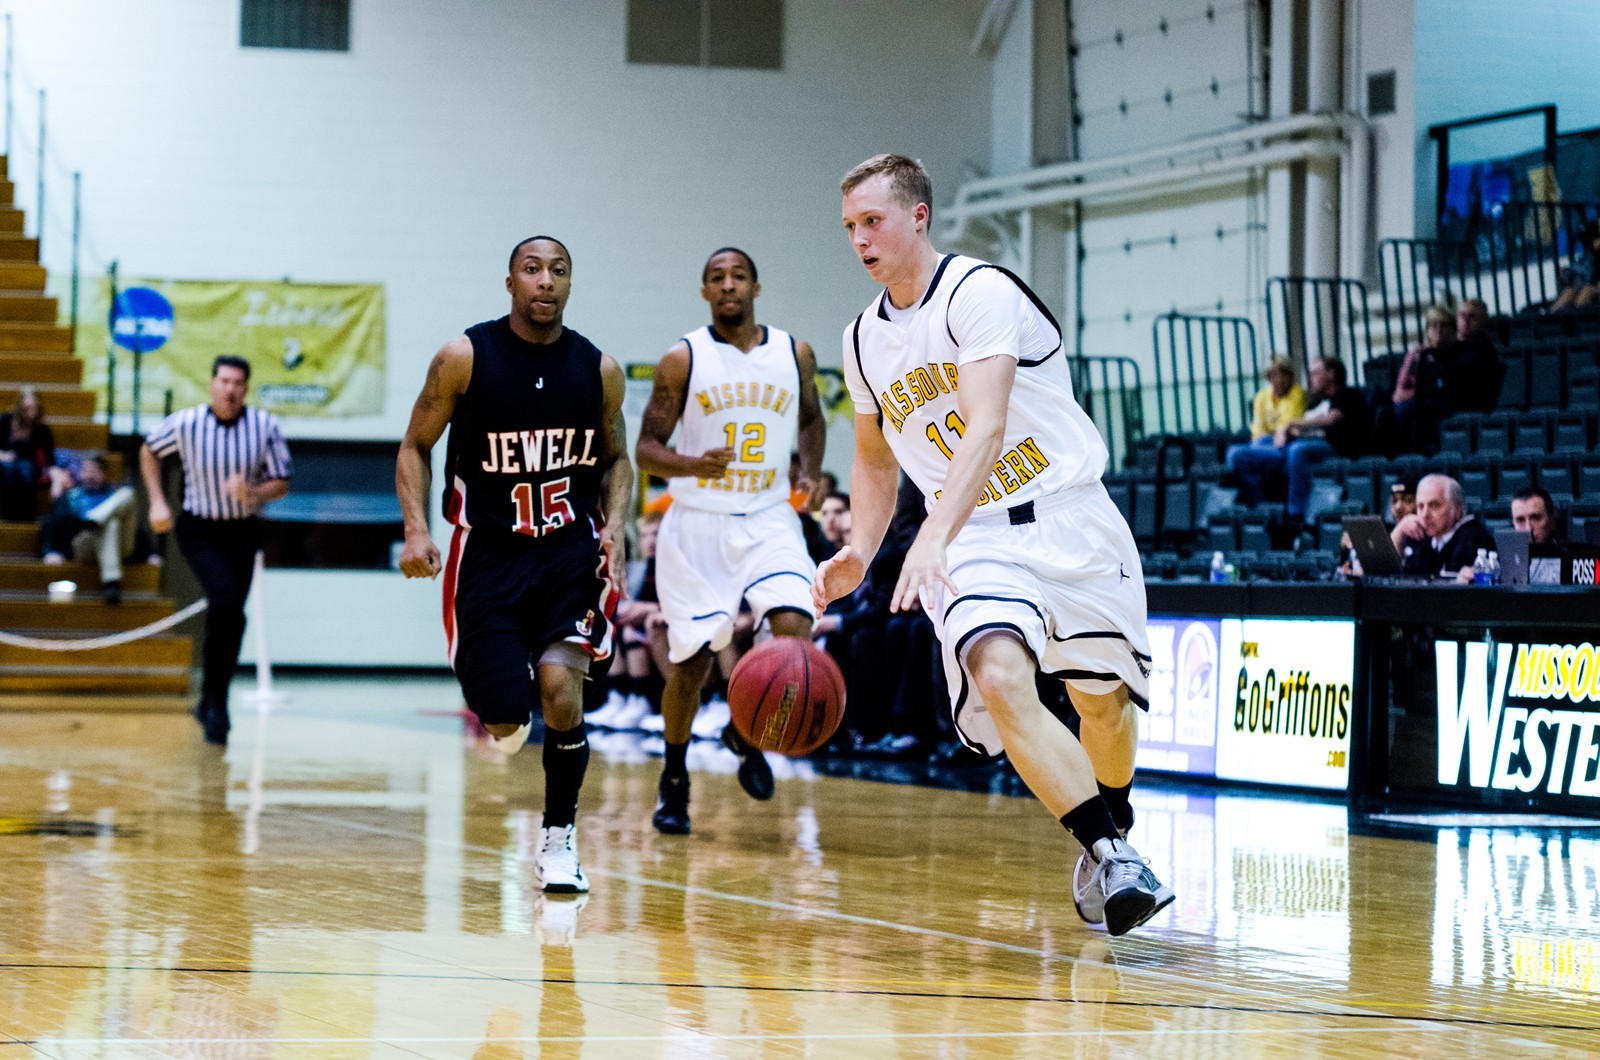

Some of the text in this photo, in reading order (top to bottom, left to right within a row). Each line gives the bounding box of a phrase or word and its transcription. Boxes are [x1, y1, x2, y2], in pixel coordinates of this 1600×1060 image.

[535, 377, 544, 389] J
[880, 362, 959, 434] MISSOUR
[481, 427, 598, 474] JEWELL
[723, 422, 766, 462] 12
[510, 476, 576, 538] 15
[1572, 558, 1595, 585] POSS
[1234, 665, 1350, 740] GoGriffons
